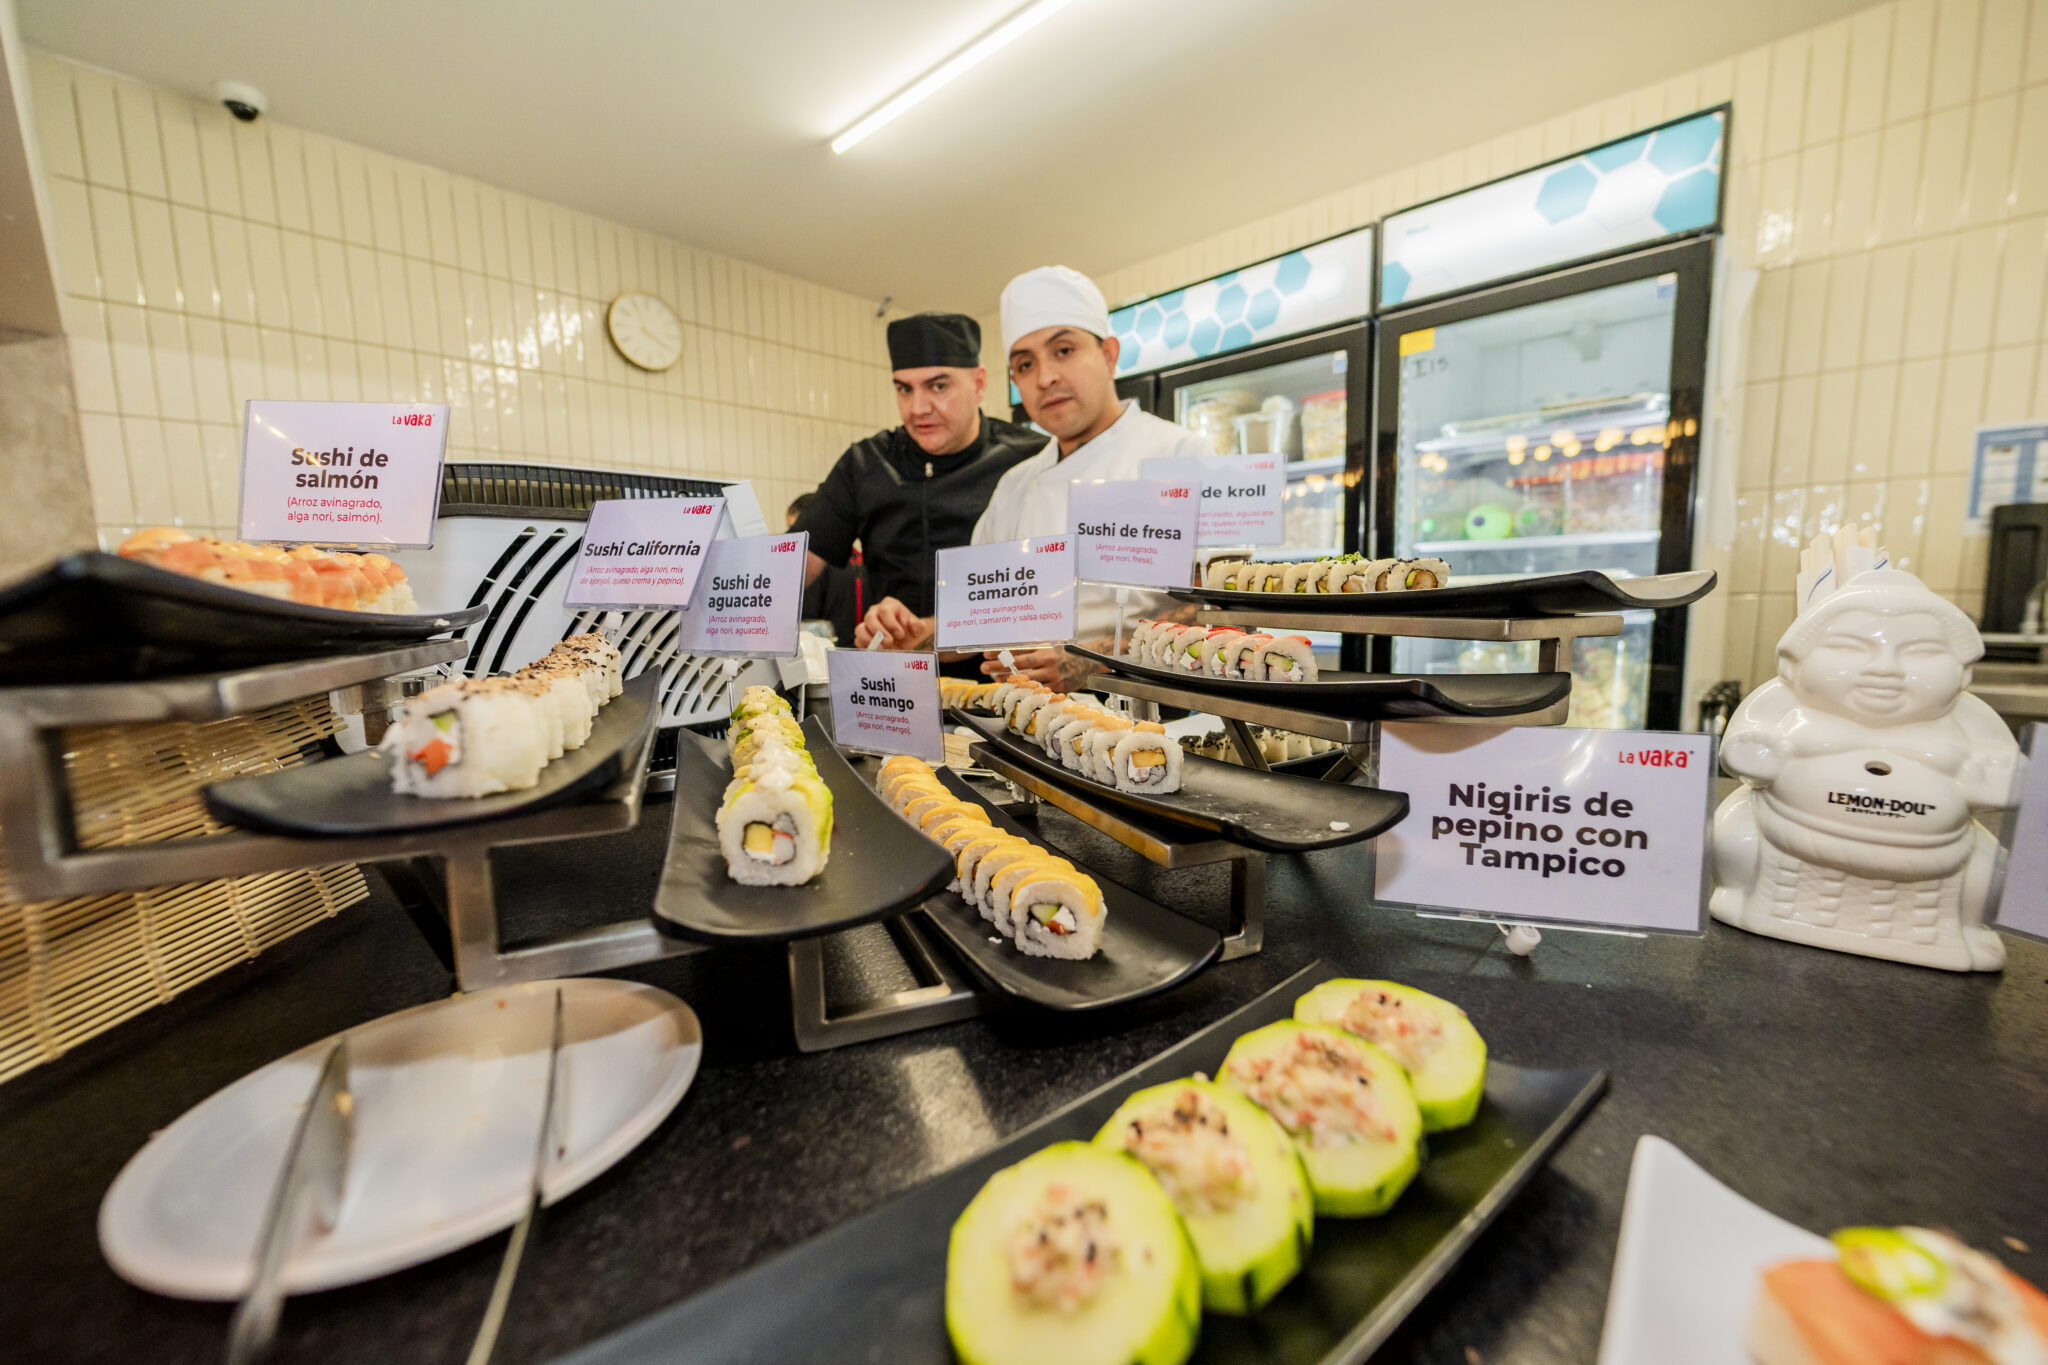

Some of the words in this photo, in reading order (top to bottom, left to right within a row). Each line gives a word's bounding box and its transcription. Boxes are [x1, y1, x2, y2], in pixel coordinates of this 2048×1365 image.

[392, 416, 401, 425] La
[291, 447, 353, 466] Sushi
[360, 449, 388, 467] de
[296, 470, 378, 489] salmón
[1202, 487, 1222, 498] de
[1228, 485, 1265, 497] kroll
[287, 496, 317, 507] (Arroz
[320, 497, 382, 509] avinagrado,
[287, 512, 309, 523] alga
[312, 512, 334, 522] nori,
[337, 513, 382, 524] salmón).
[1078, 522, 1115, 537] Sushi
[1120, 524, 1137, 538] de
[1143, 525, 1181, 540] fresa
[585, 542, 625, 556] Sushi
[627, 540, 701, 556] California
[1117, 546, 1158, 554] avinagrado,
[1099, 554, 1114, 563] alga
[1116, 555, 1130, 563] nori,
[713, 574, 750, 590] Sushi
[753, 574, 770, 589] de
[967, 568, 1010, 586] Sushi
[1015, 567, 1035, 582] de
[968, 583, 1038, 601] camarón
[708, 595, 772, 611] aguacate
[970, 607, 990, 616] (Arroz
[992, 604, 1035, 614] avinagrado,
[709, 615, 727, 623] (Arroz
[729, 614, 766, 624] avinagrado,
[979, 616, 1011, 625] camarón
[1039, 611, 1064, 621] spicy).
[706, 627, 718, 635] alga
[720, 627, 733, 635] nori,
[861, 677, 895, 692] Sushi
[851, 691, 866, 705] de
[869, 695, 914, 712] mango
[856, 711, 873, 719] (Arroz
[875, 713, 910, 724] avinagrado,
[858, 721, 871, 730] alga
[1619, 751, 1634, 764] La
[1449, 783, 1571, 815] Nigiris
[1584, 792, 1633, 818] de
[1432, 814, 1563, 843] pepino
[1576, 826, 1648, 849] con
[1459, 842, 1625, 878] Tampico
